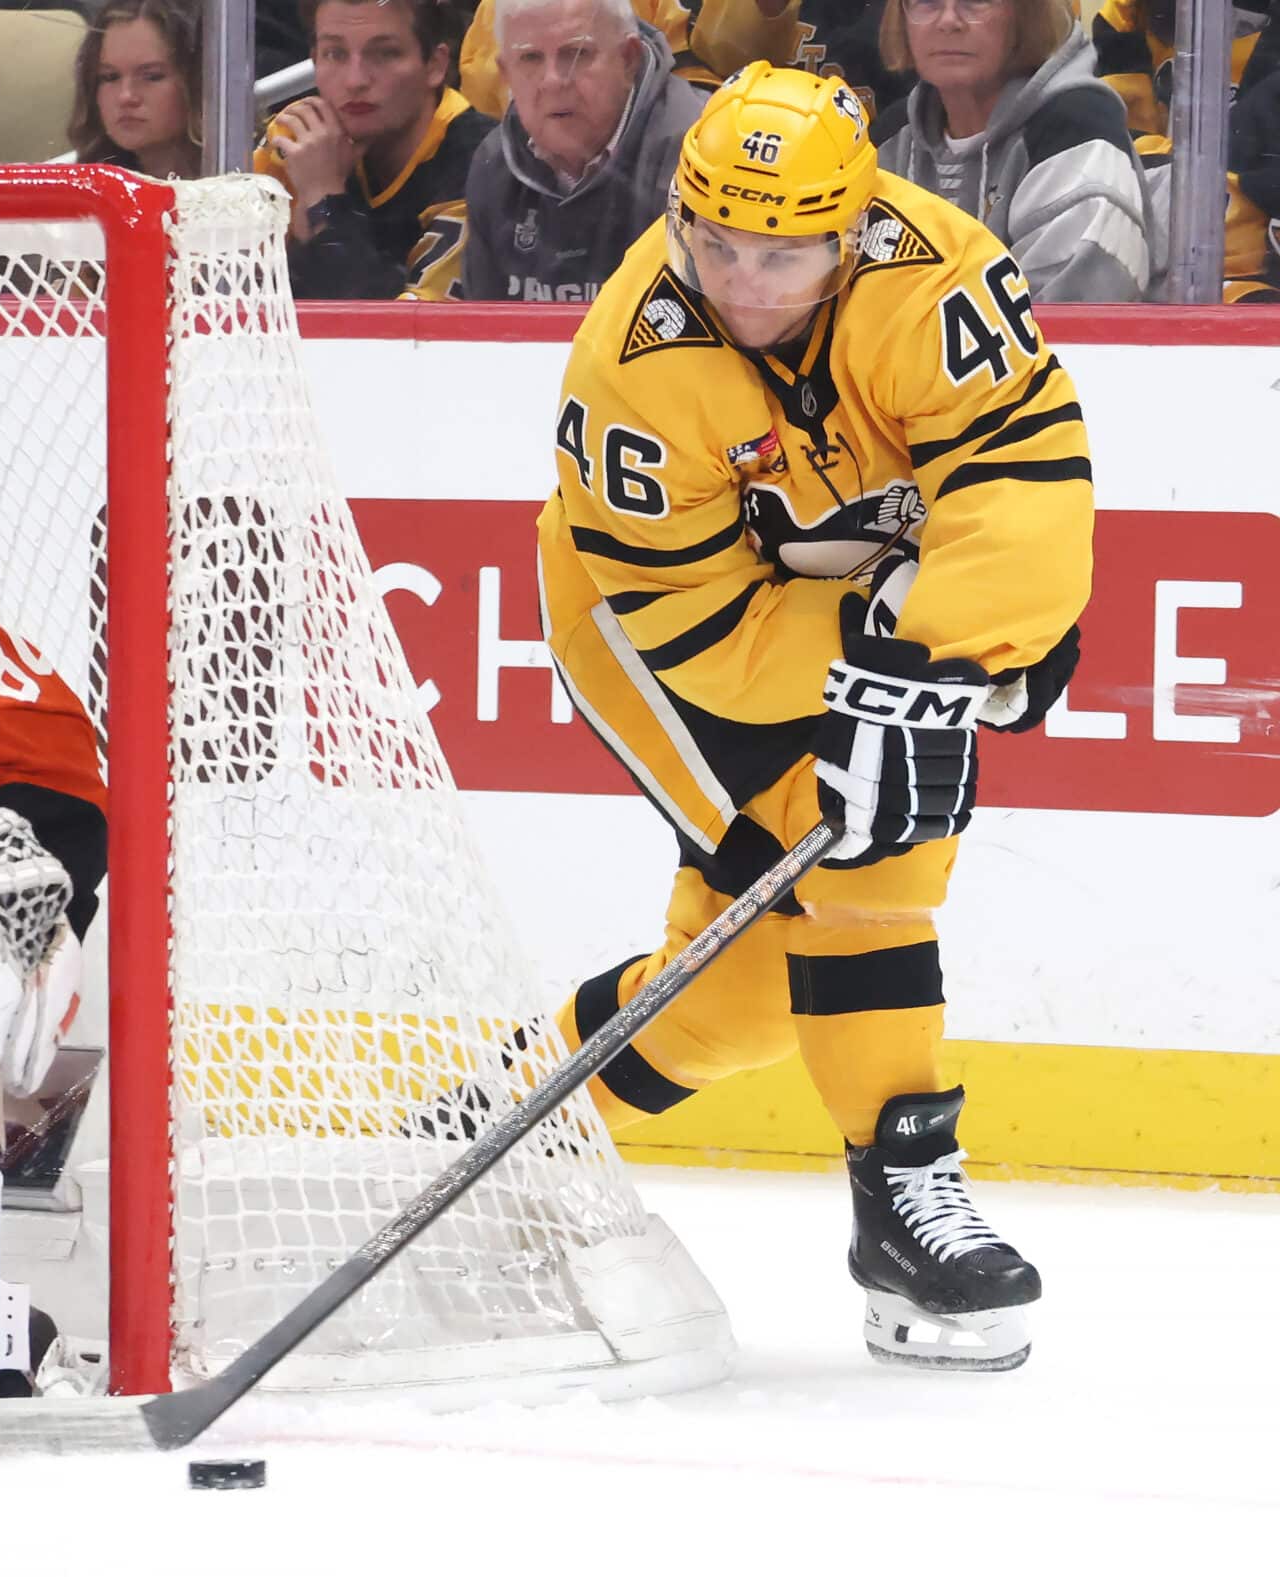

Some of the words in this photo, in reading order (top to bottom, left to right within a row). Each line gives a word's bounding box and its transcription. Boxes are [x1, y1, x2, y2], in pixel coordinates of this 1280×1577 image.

[742, 130, 782, 164] 46
[720, 184, 786, 206] CCM
[938, 254, 1038, 386] 46
[556, 395, 668, 519] 46
[880, 1241, 917, 1276] BAUER
